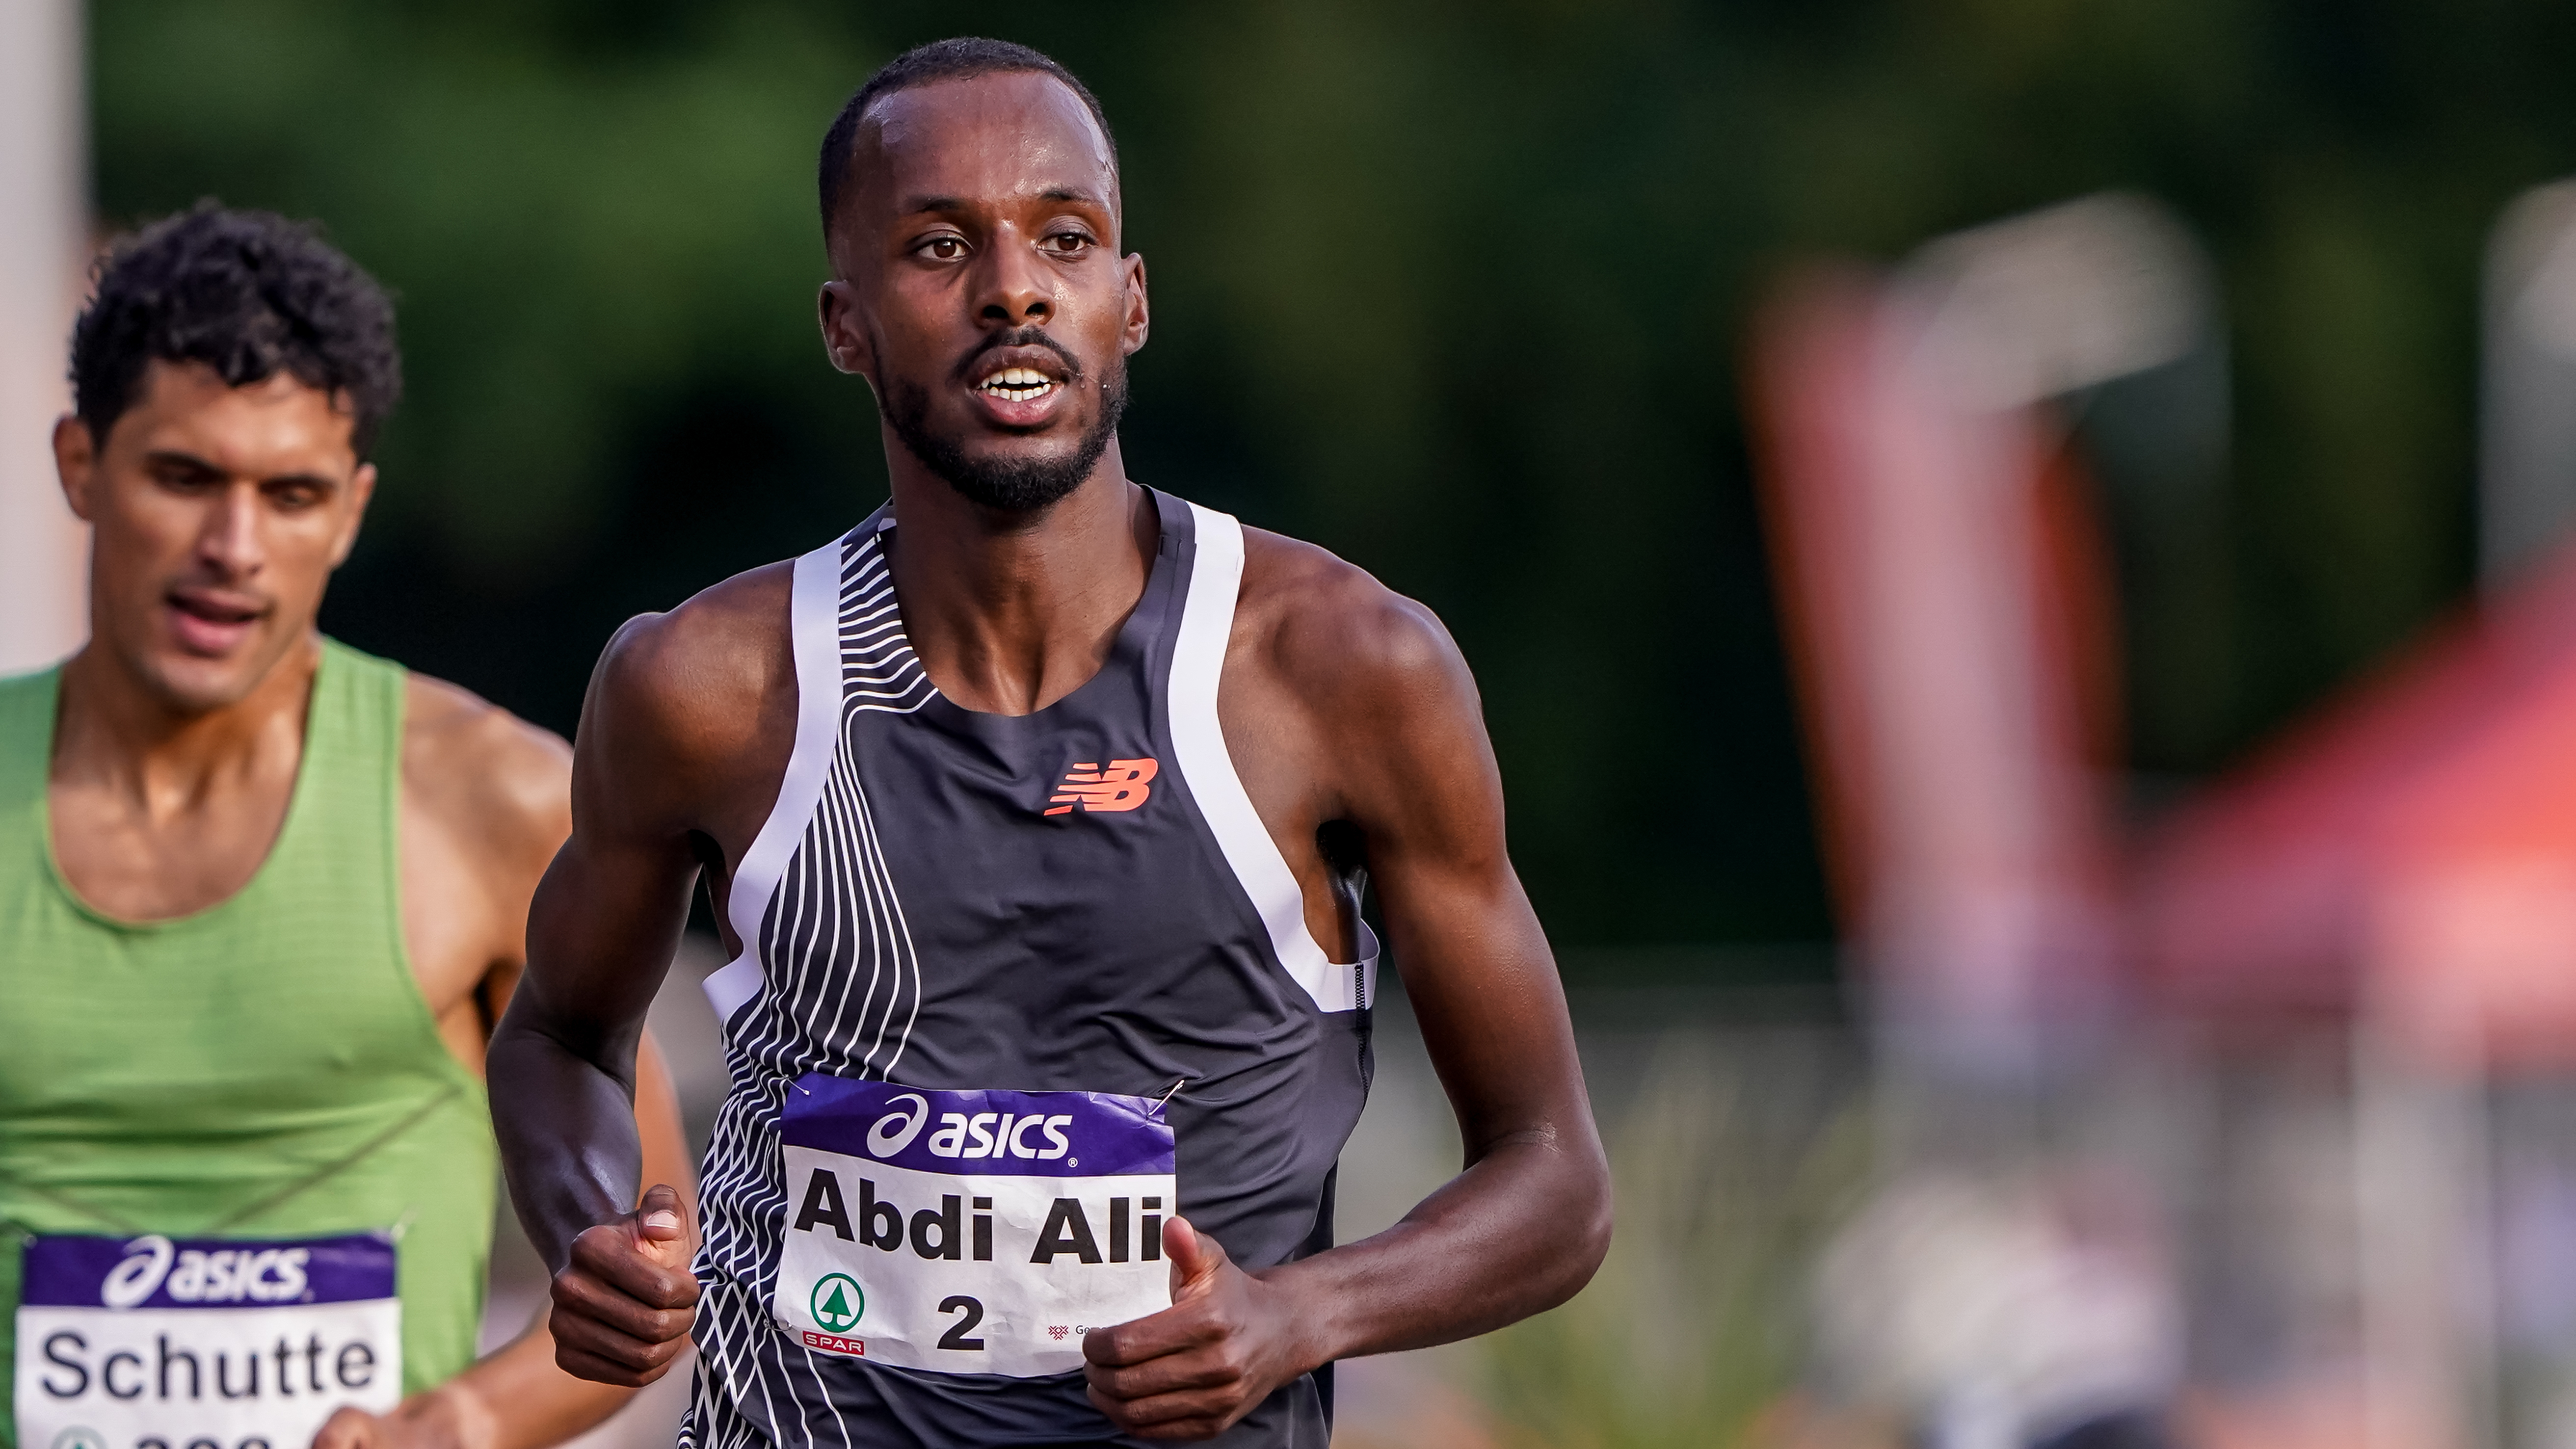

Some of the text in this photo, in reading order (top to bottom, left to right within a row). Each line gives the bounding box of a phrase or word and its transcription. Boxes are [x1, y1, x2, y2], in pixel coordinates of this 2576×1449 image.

[794, 1168, 1162, 1264] Abdi Ali
[805, 1334, 862, 1352] SPAR
[937, 1296, 984, 1350] 2
[41, 1330, 375, 1399] Schutte
